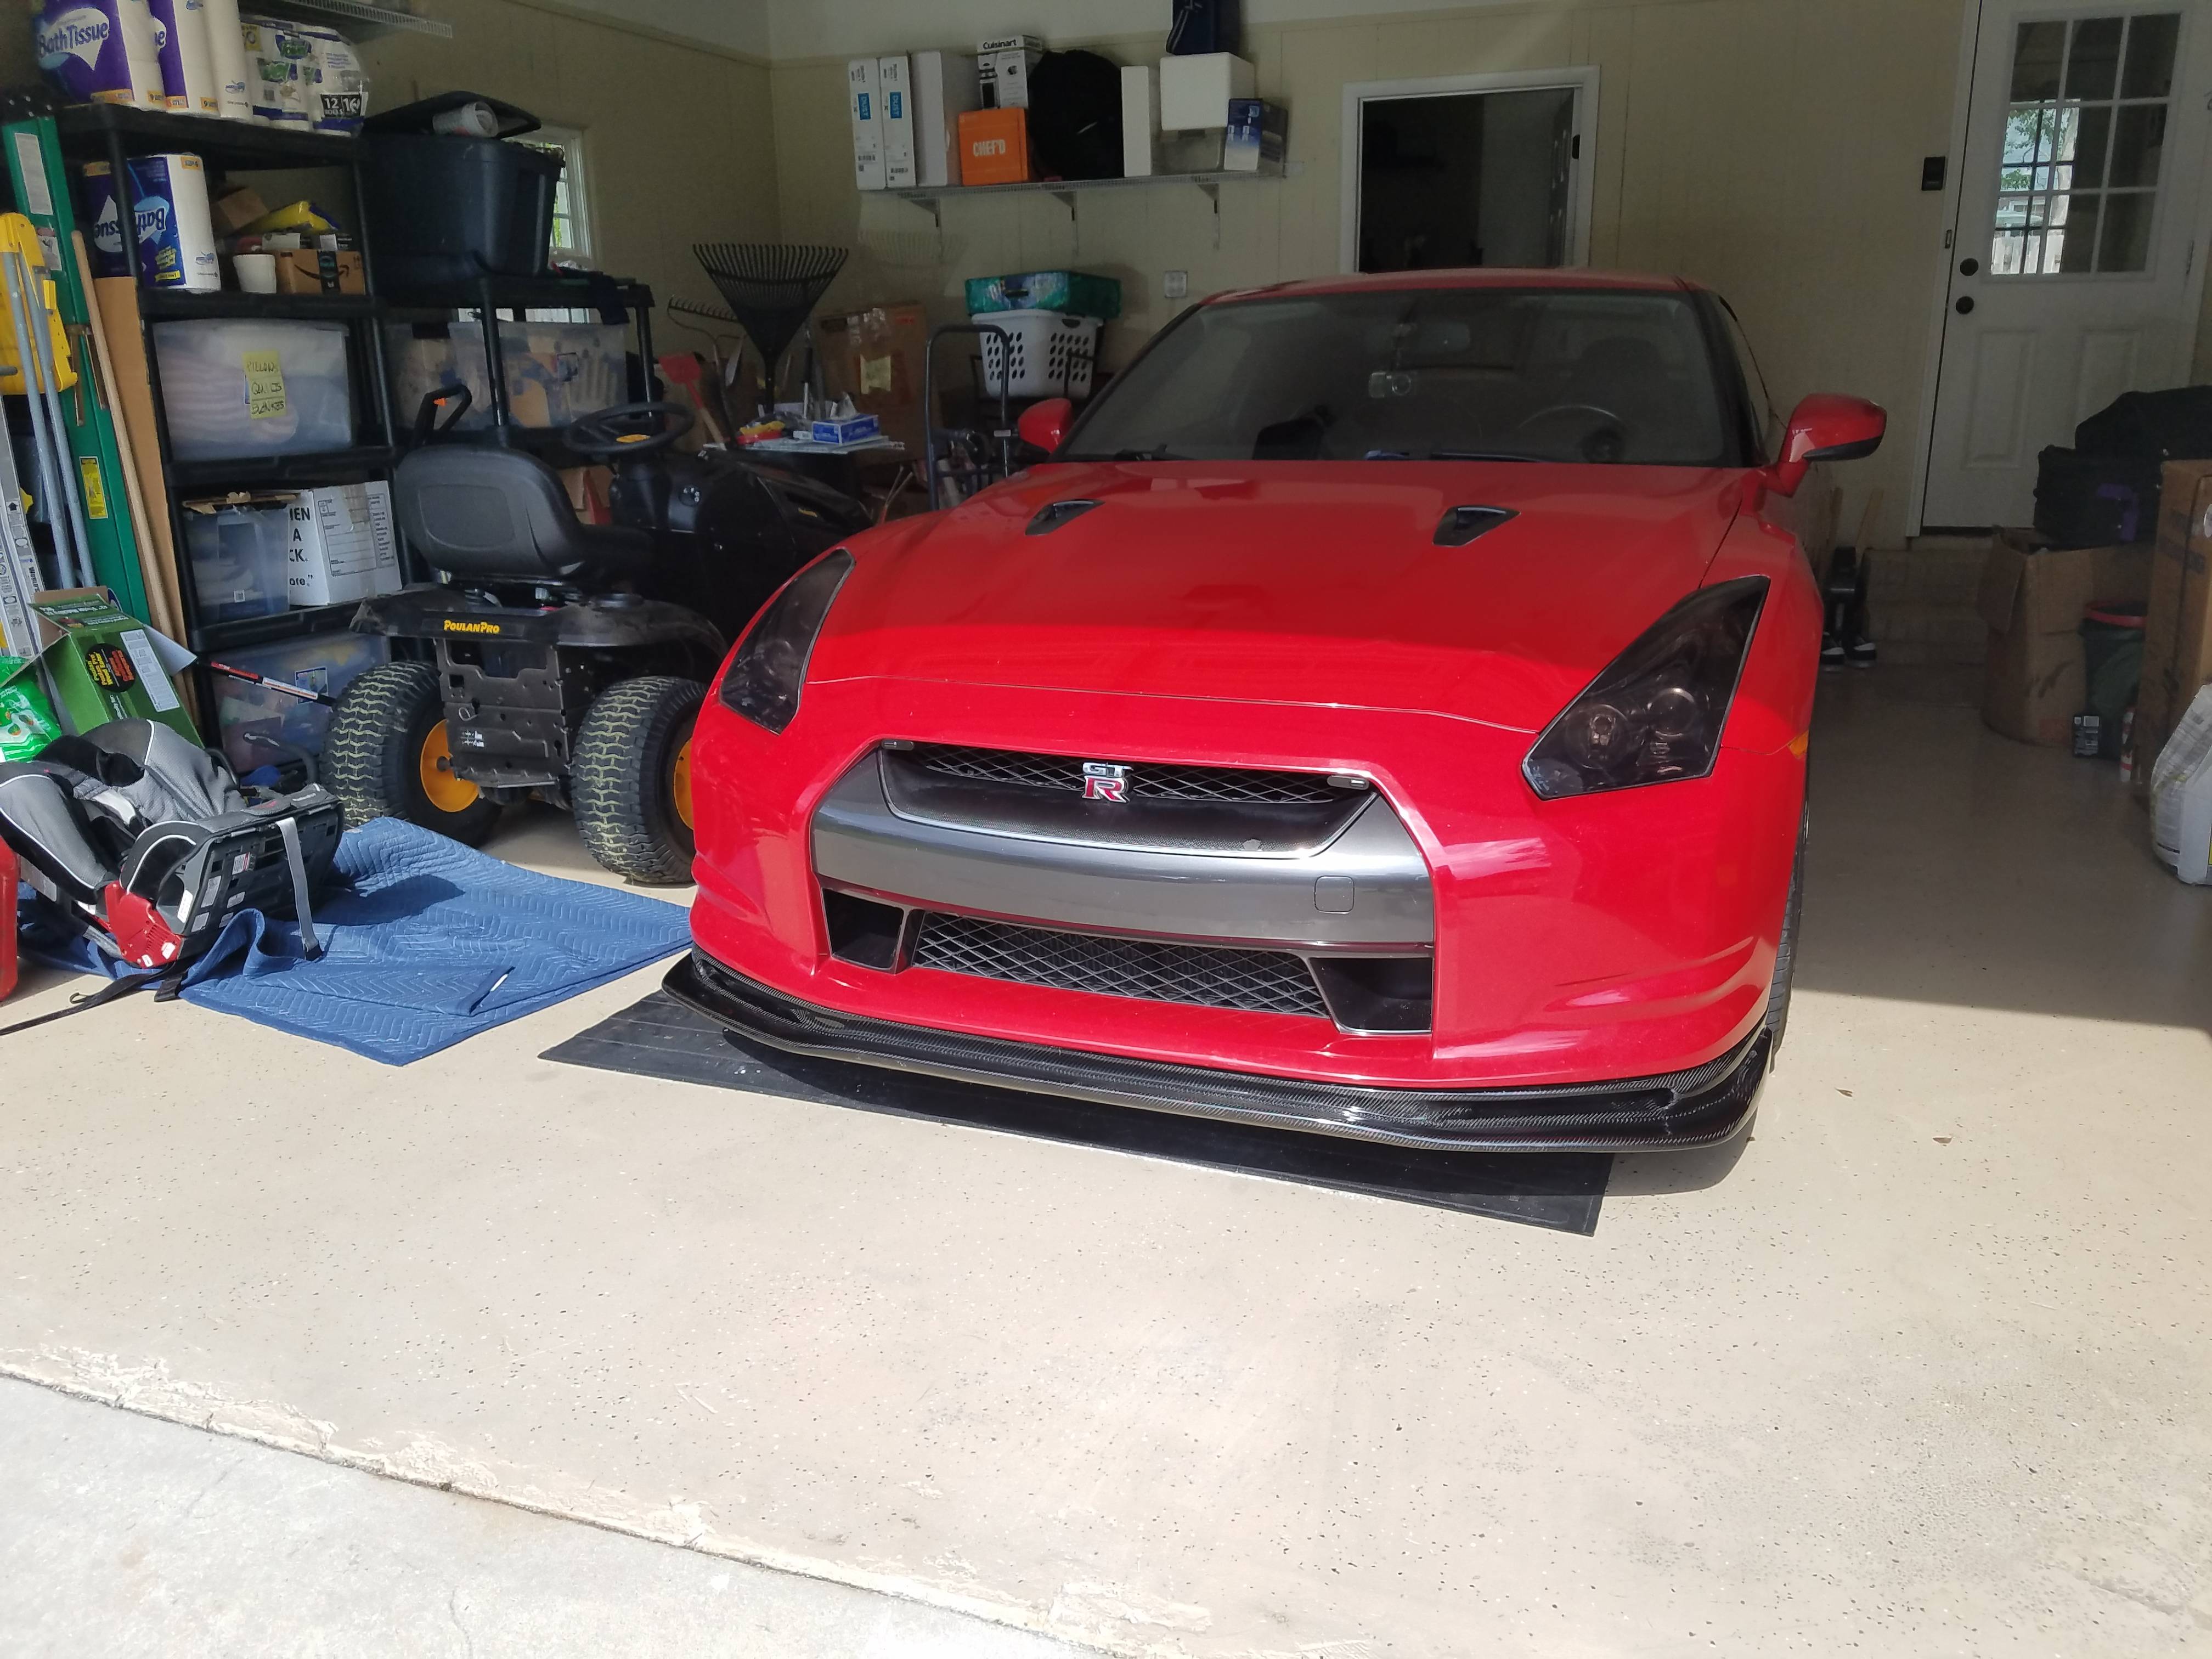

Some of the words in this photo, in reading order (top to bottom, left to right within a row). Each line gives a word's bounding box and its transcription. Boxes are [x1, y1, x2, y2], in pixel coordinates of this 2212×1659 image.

[983, 39, 1017, 49] Cuisinart
[324, 98, 339, 109] 12
[293, 528, 302, 542] A
